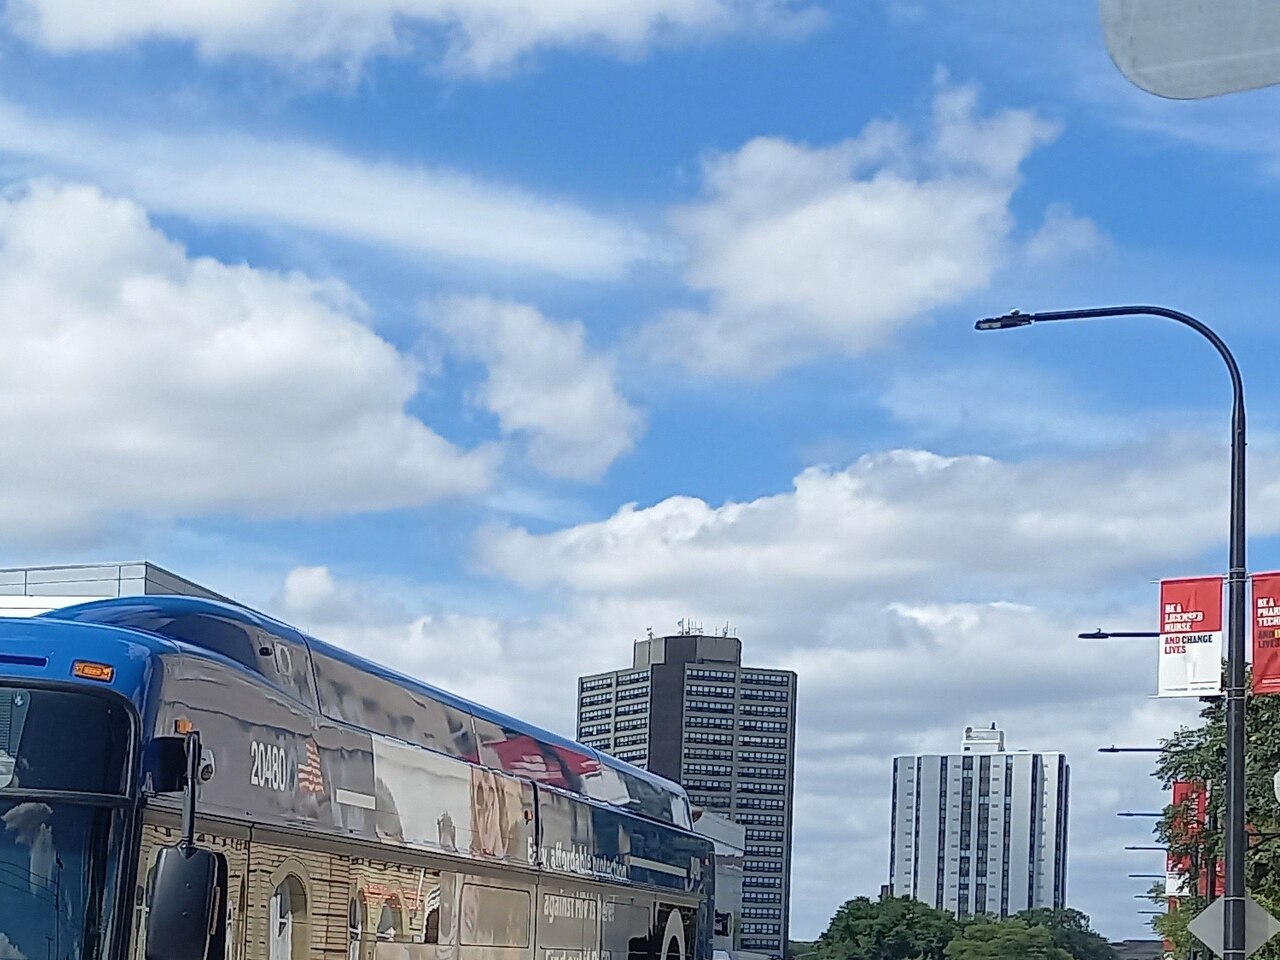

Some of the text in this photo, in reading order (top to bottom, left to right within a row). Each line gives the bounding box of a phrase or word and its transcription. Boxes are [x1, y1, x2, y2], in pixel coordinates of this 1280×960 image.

[1257, 597, 1274, 607] BE A
[1164, 603, 1182, 613] BE A
[1164, 611, 1204, 623] LICENSED
[1257, 617, 1280, 627] TECH
[1164, 622, 1192, 632] NURSE
[1164, 634, 1213, 645] AND CHANGE
[1164, 645, 1186, 655] LIVES
[250, 740, 287, 792] 20480
[550, 841, 593, 876] affordable
[543, 888, 575, 924] against
